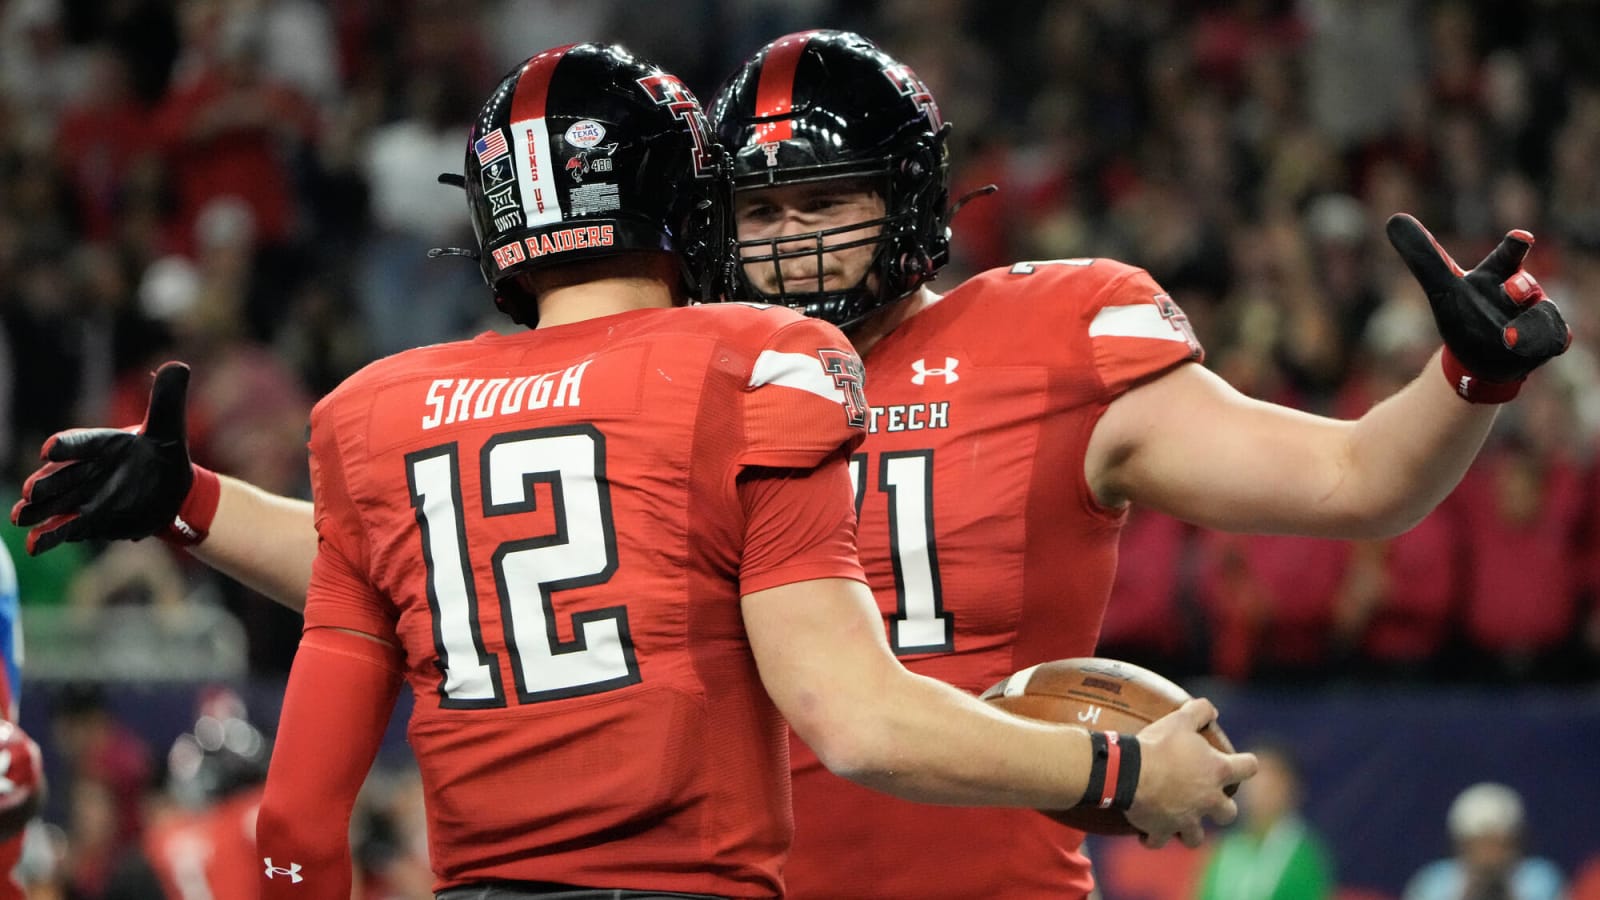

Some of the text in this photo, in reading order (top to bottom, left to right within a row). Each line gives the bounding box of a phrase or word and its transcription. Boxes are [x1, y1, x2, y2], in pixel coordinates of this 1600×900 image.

[572, 128, 599, 139] TEXAS
[526, 129, 545, 214] GUNS UP
[494, 211, 522, 232] UNITY
[492, 225, 614, 270] RED RAIDERS
[422, 360, 593, 430] SHOUGH
[868, 401, 950, 433] TECH
[404, 422, 643, 710] 12
